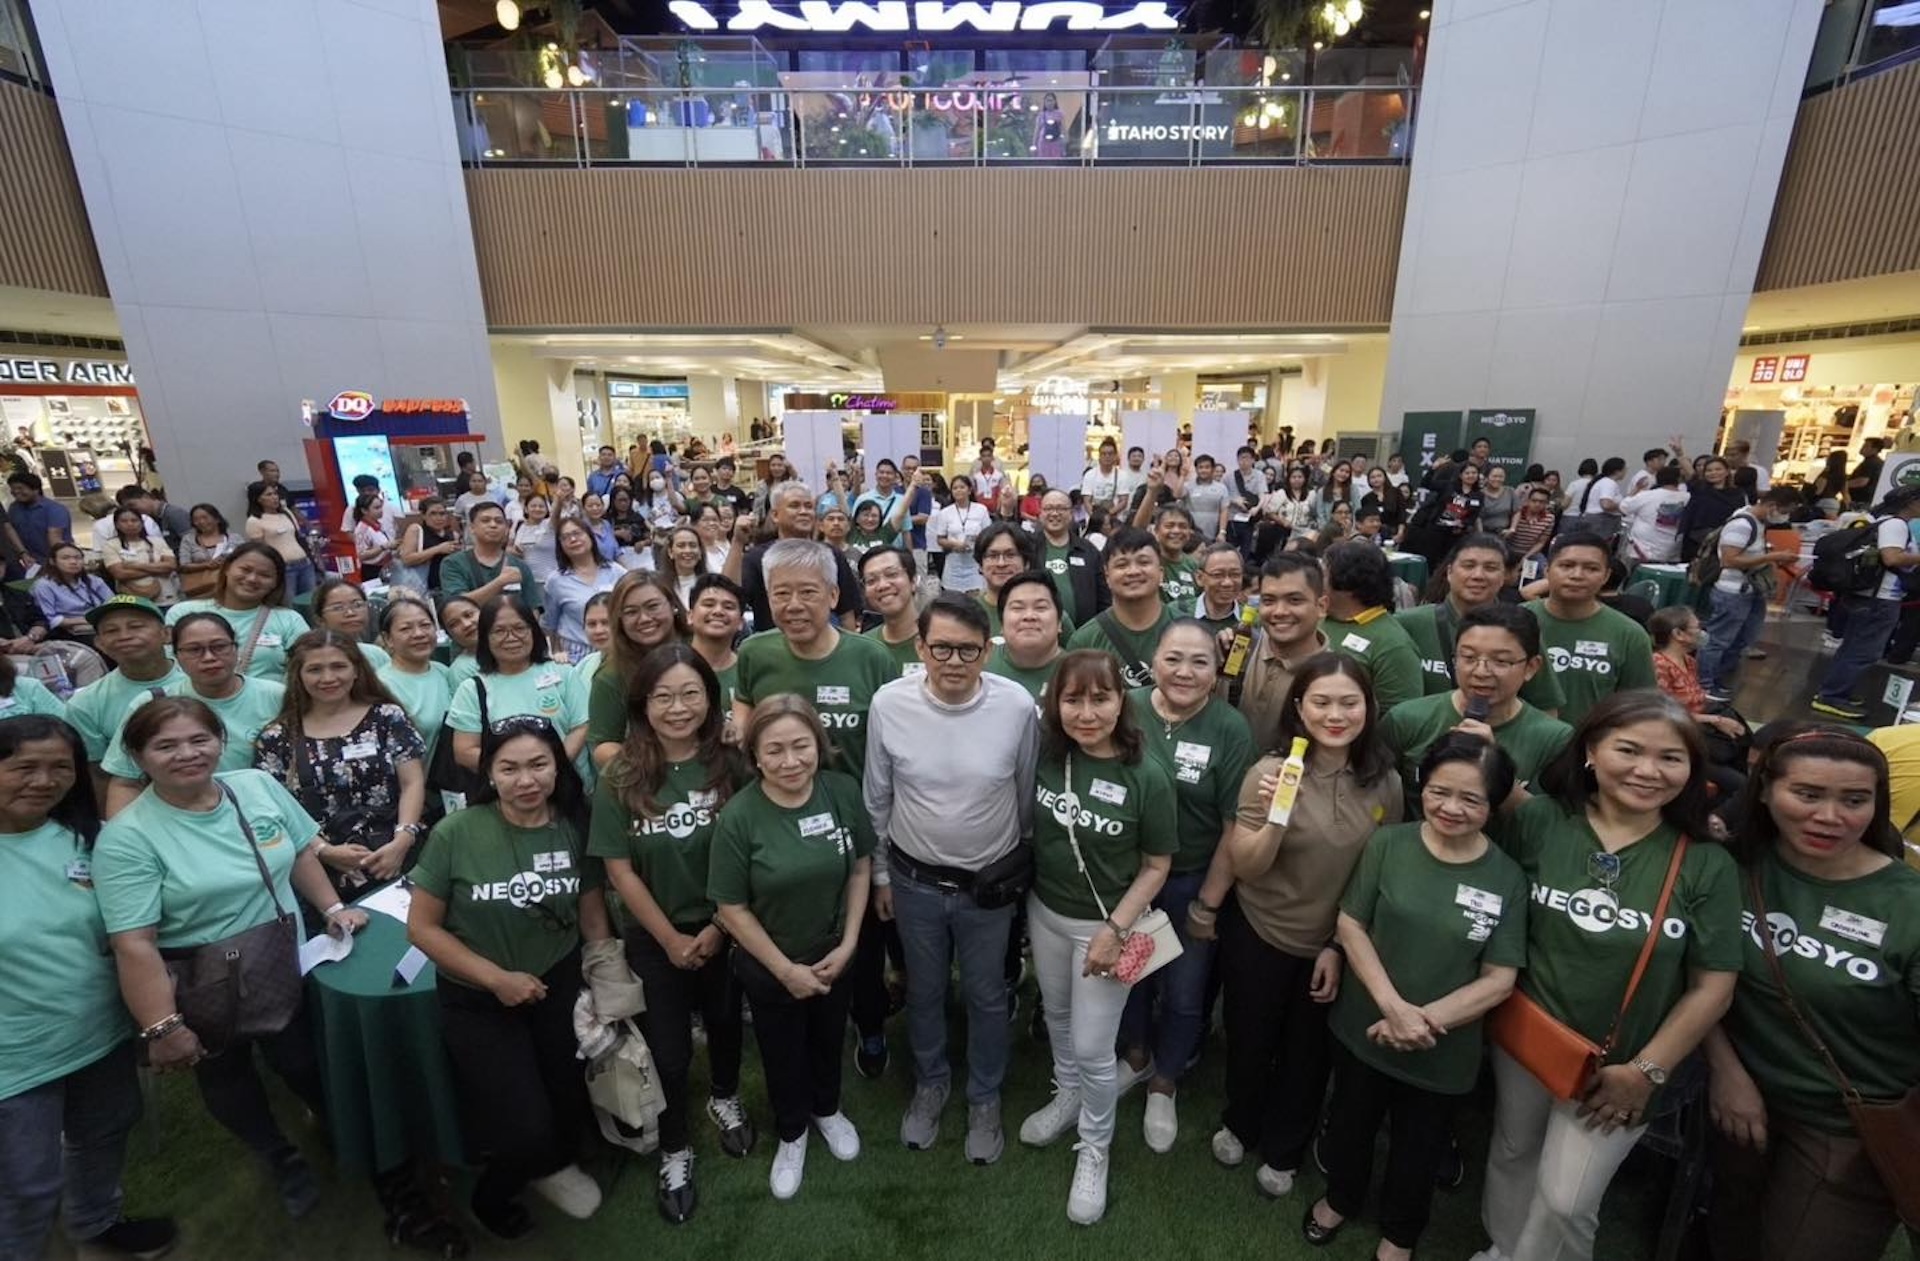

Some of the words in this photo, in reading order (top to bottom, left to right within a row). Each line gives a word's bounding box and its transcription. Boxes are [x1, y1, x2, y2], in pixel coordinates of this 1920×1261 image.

[1119, 125, 1167, 140] TAHO
[1169, 125, 1229, 140] STORY
[337, 397, 368, 413] DQ
[1481, 415, 1527, 425] NEGOSYO
[1891, 683, 1902, 698] 3
[632, 807, 720, 837] NEGOS
